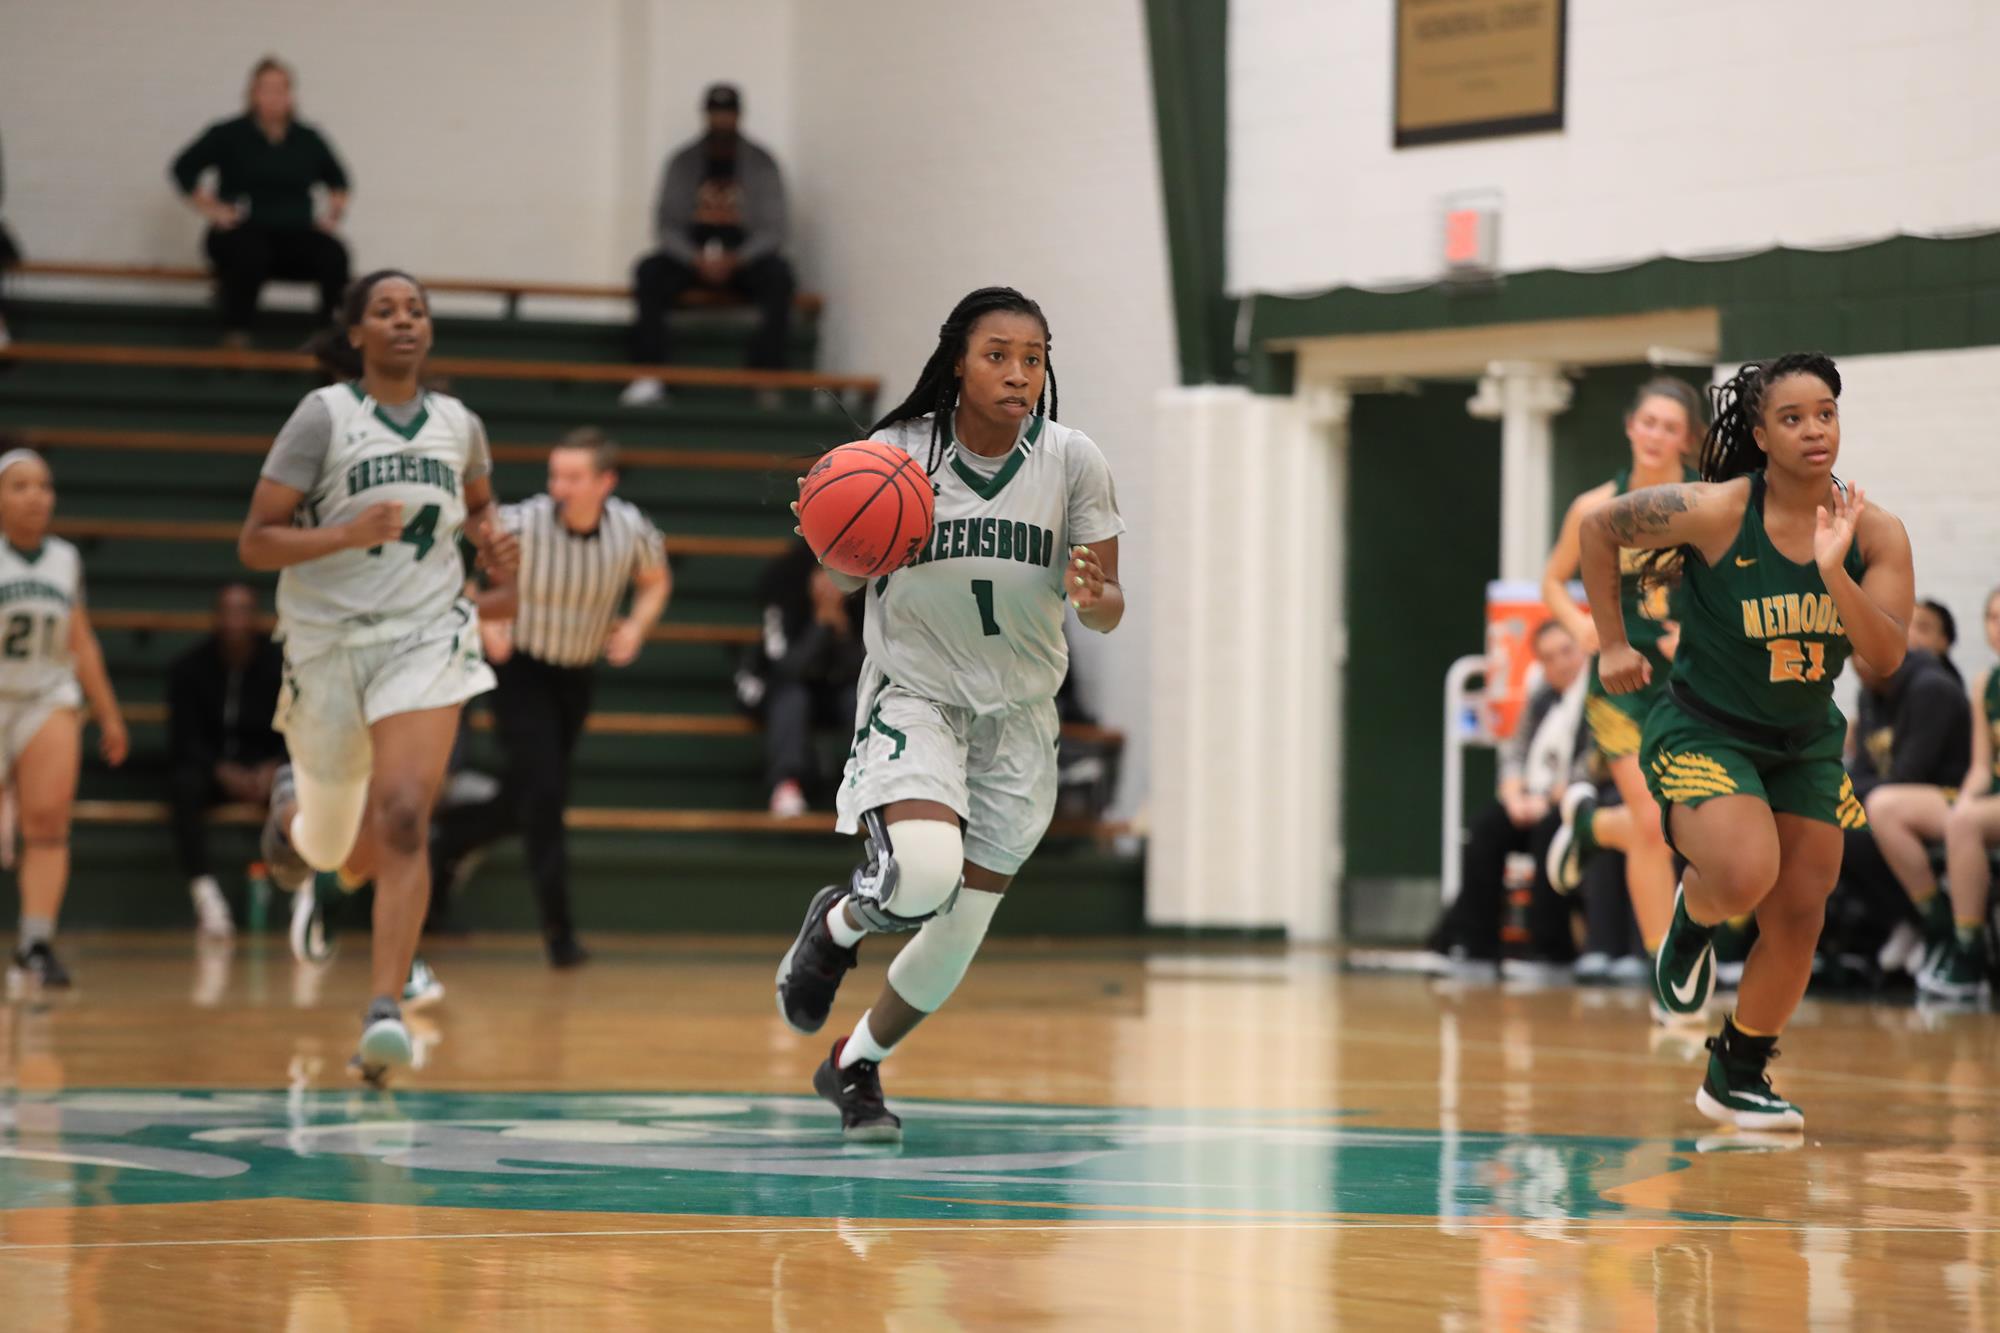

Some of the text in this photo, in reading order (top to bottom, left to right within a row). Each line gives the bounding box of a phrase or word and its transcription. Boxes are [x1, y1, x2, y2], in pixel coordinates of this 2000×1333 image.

[367, 503, 441, 562] 4
[907, 517, 1054, 569] EENSBORO
[971, 579, 1001, 636] 1
